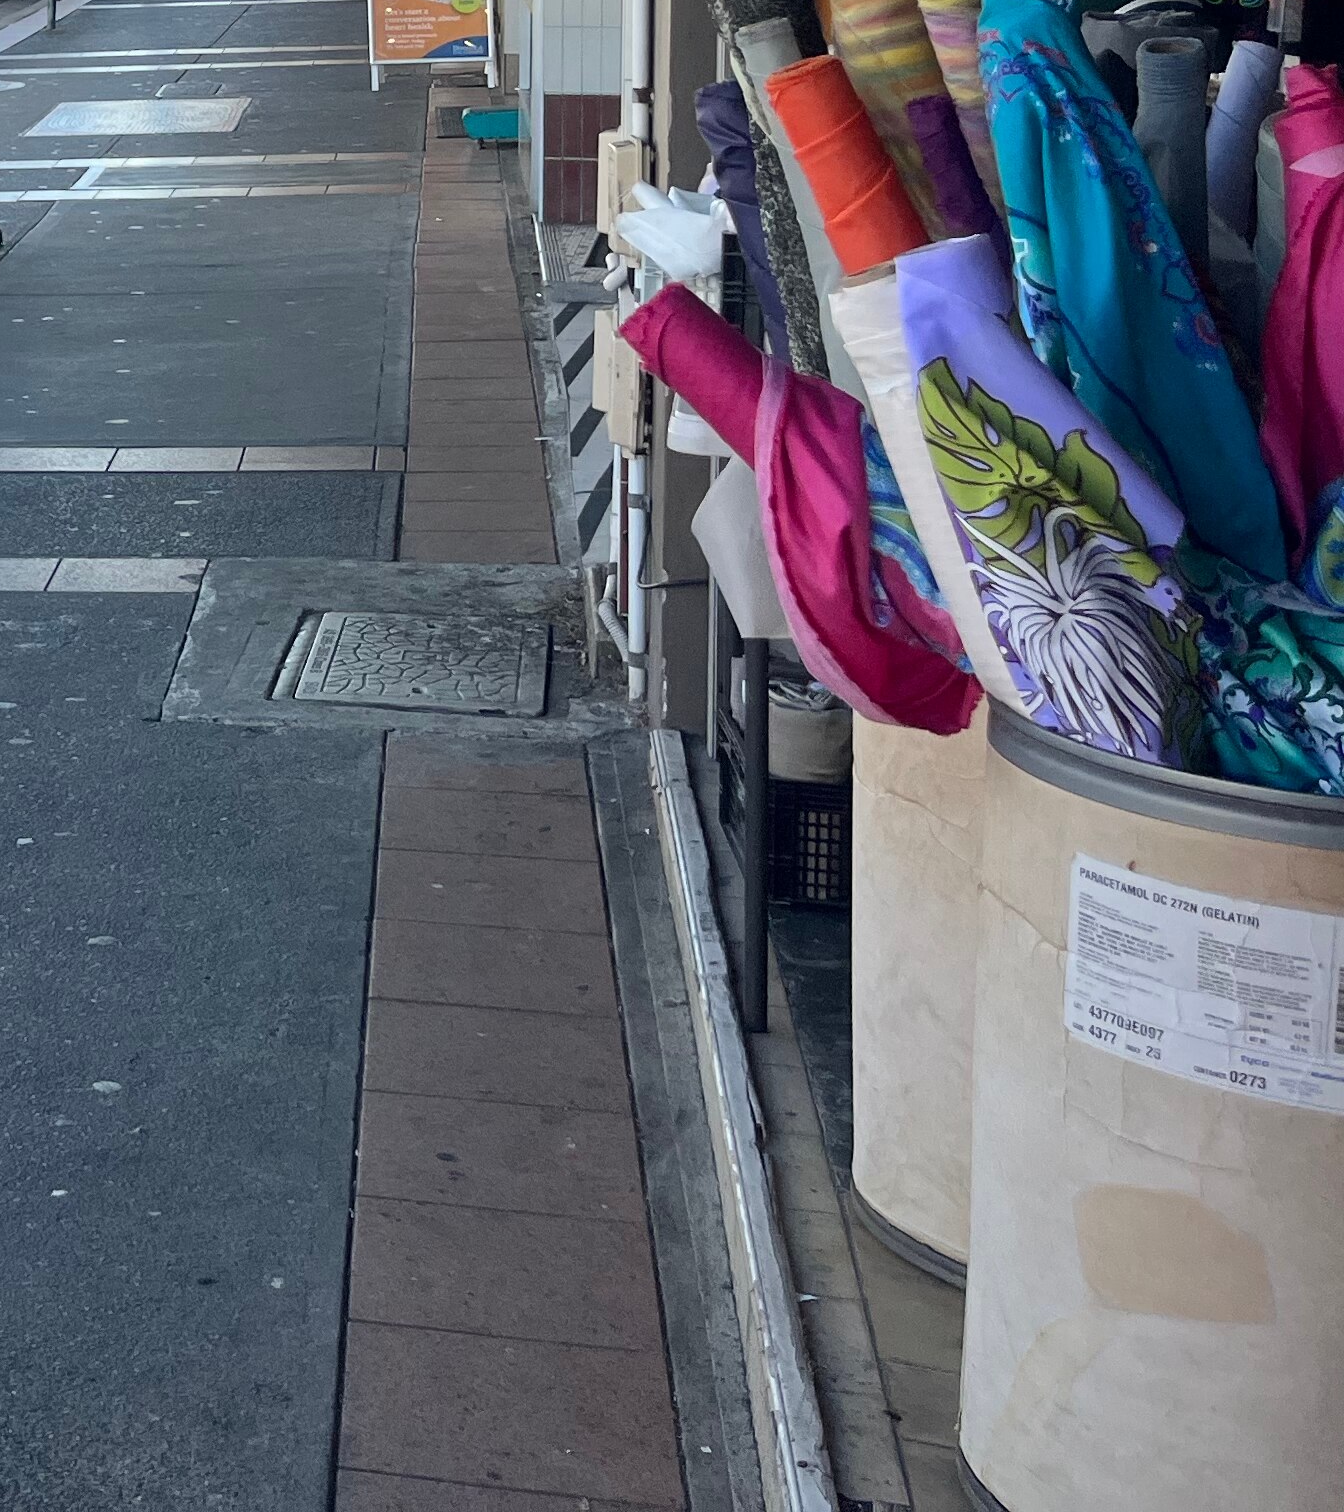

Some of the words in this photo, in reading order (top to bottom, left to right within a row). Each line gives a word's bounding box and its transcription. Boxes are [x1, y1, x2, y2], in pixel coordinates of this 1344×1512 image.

[1079, 866, 1150, 901] PARACETAMOL
[1152, 892, 1168, 906] DC
[1170, 895, 1198, 915] 272N
[1201, 905, 1261, 930] (GELATIN)
[1088, 1024, 1117, 1045] 4377
[1229, 1069, 1267, 1090] 0273
